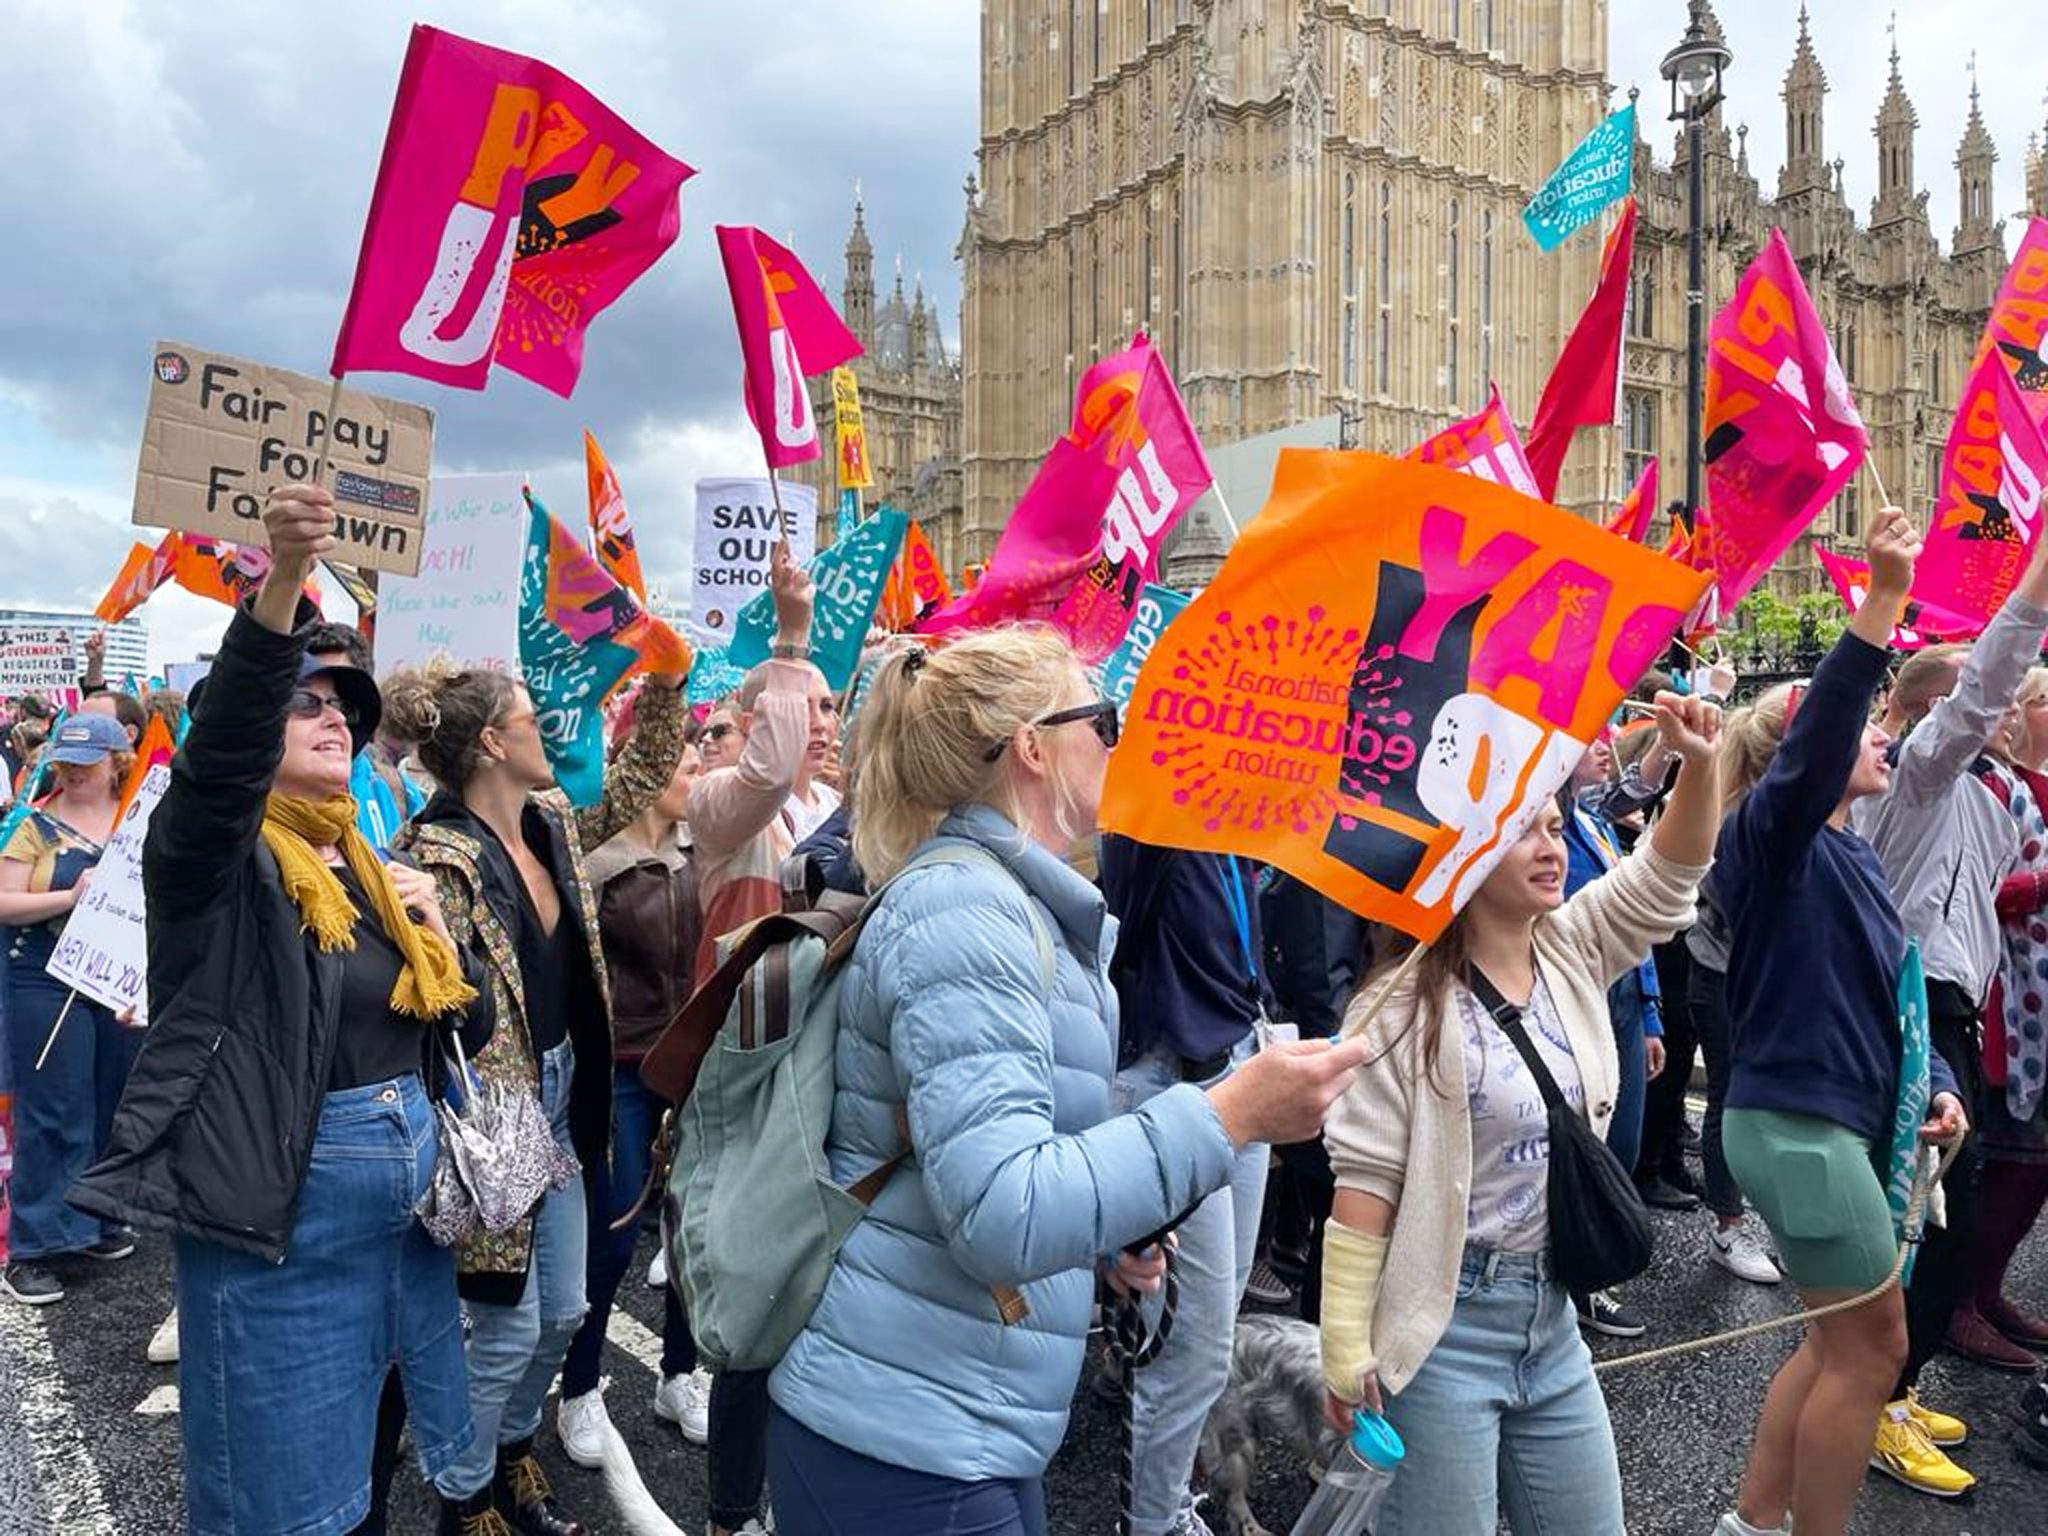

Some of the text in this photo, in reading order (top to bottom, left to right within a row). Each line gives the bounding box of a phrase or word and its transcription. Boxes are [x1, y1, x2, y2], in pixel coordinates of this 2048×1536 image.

[201, 364, 389, 466] Fair pay
[713, 505, 798, 535] SAVE
[698, 567, 773, 586] SCHO
[16, 631, 49, 643] THIS
[0, 673, 75, 685] MPROVEMENT
[114, 964, 146, 997] YOU
